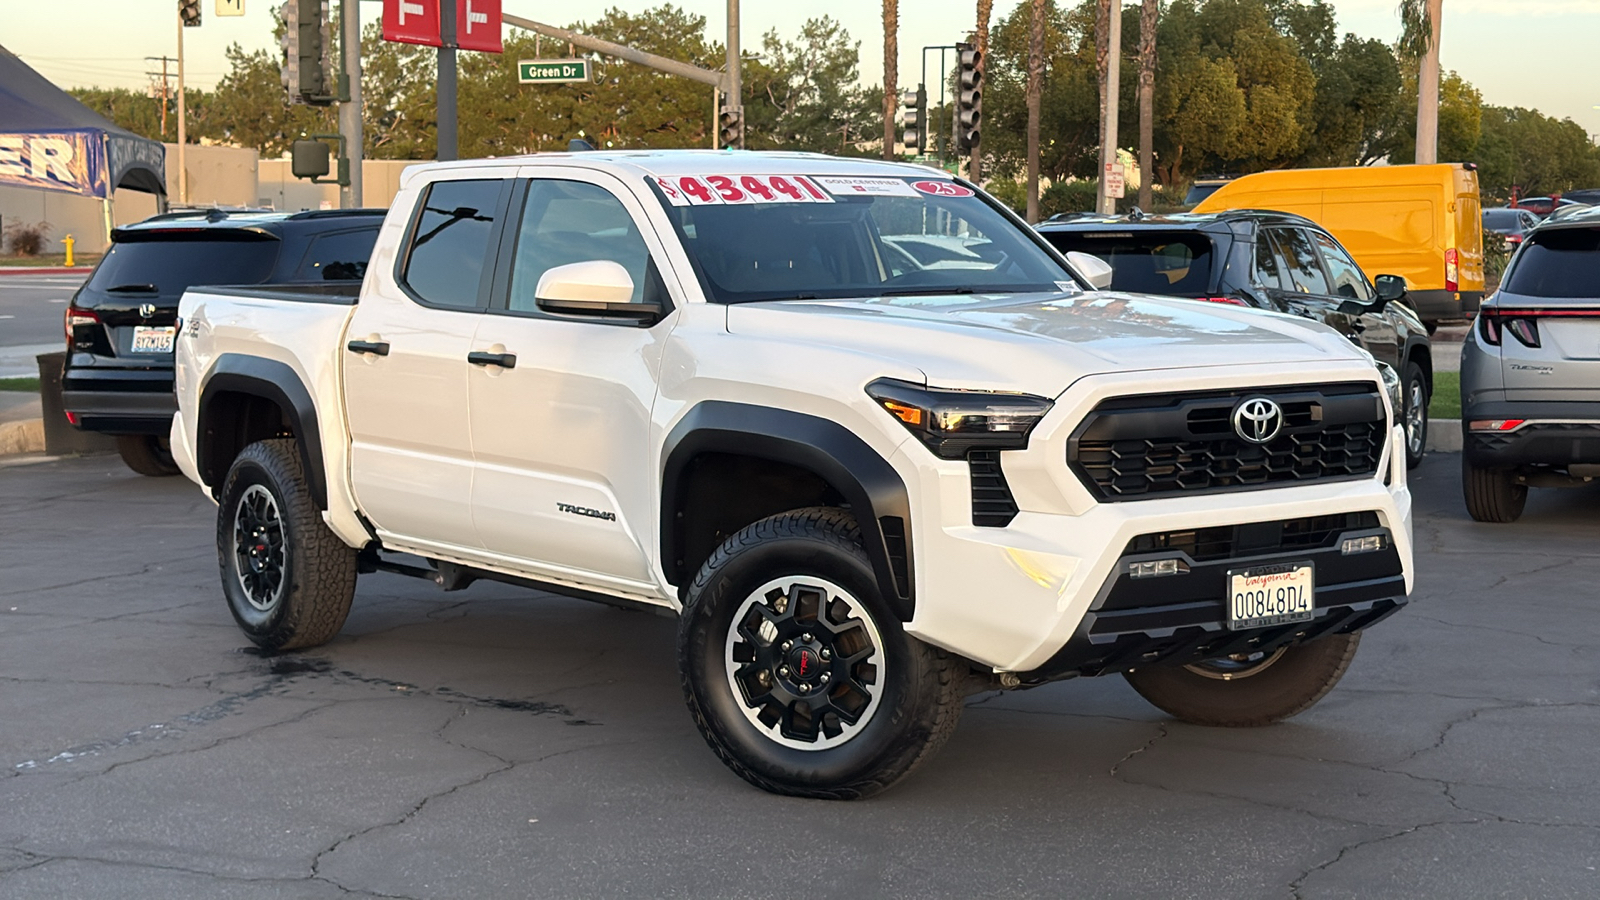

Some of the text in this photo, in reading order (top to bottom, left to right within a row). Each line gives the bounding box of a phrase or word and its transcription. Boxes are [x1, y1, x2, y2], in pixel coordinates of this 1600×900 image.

[529, 66, 577, 78] Green Dr
[824, 178, 900, 187] GOLD CERTIFIED
[928, 182, 956, 195] 25
[1509, 363, 1554, 371] TUCSON
[556, 502, 616, 522] TACOMA
[1245, 572, 1297, 588] California
[1235, 585, 1307, 619] 00848D4
